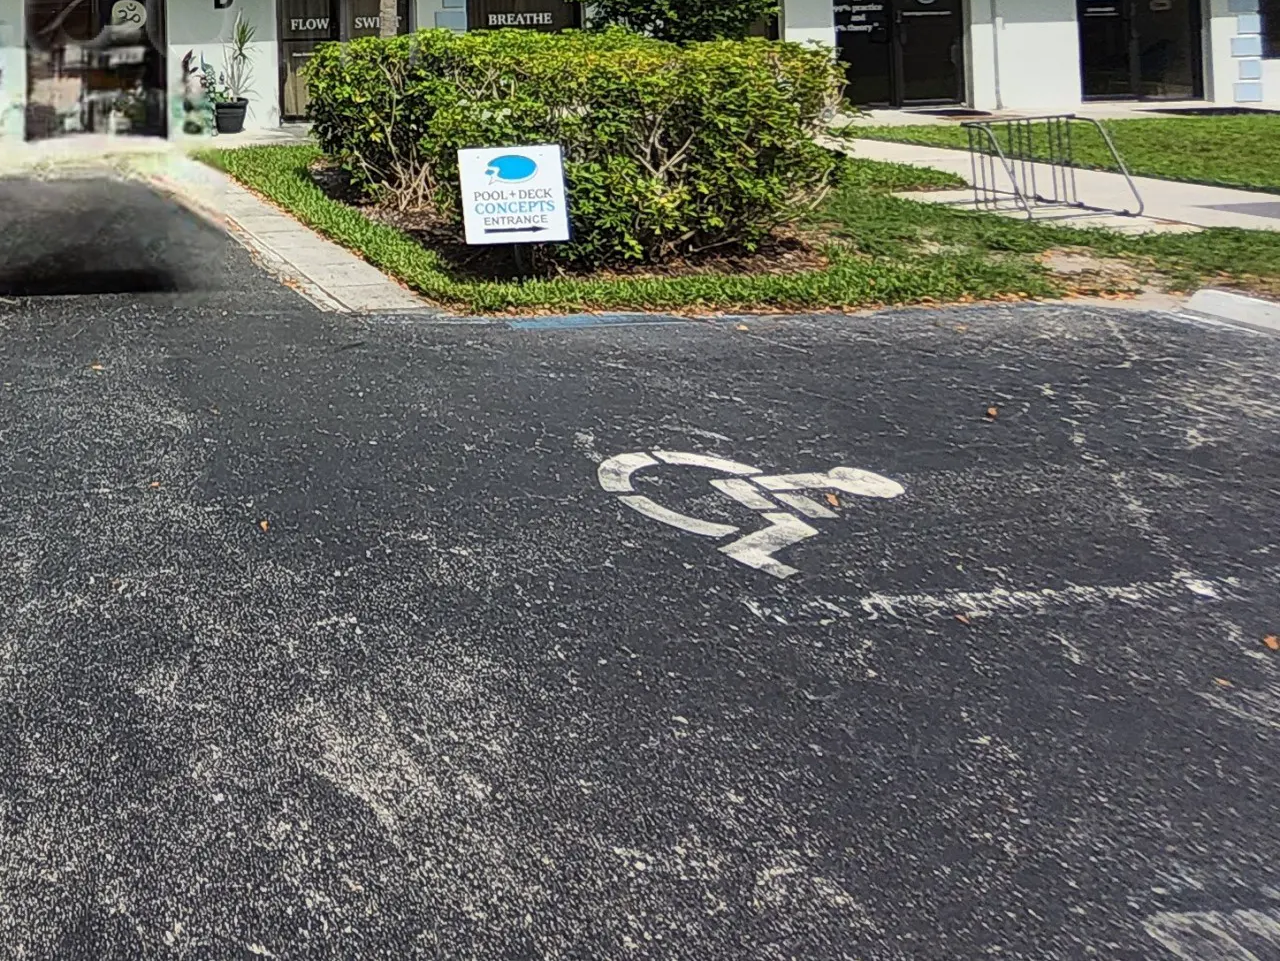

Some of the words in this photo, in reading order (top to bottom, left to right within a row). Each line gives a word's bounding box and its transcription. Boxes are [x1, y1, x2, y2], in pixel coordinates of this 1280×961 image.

[290, 18, 330, 31] FLOW
[354, 16, 402, 29] SWT
[487, 12, 553, 26] BREATHE
[473, 190, 508, 202] POOL
[518, 187, 553, 199] DECK
[474, 199, 556, 215] CONCEPTS
[483, 214, 549, 226] ENTRANCE
